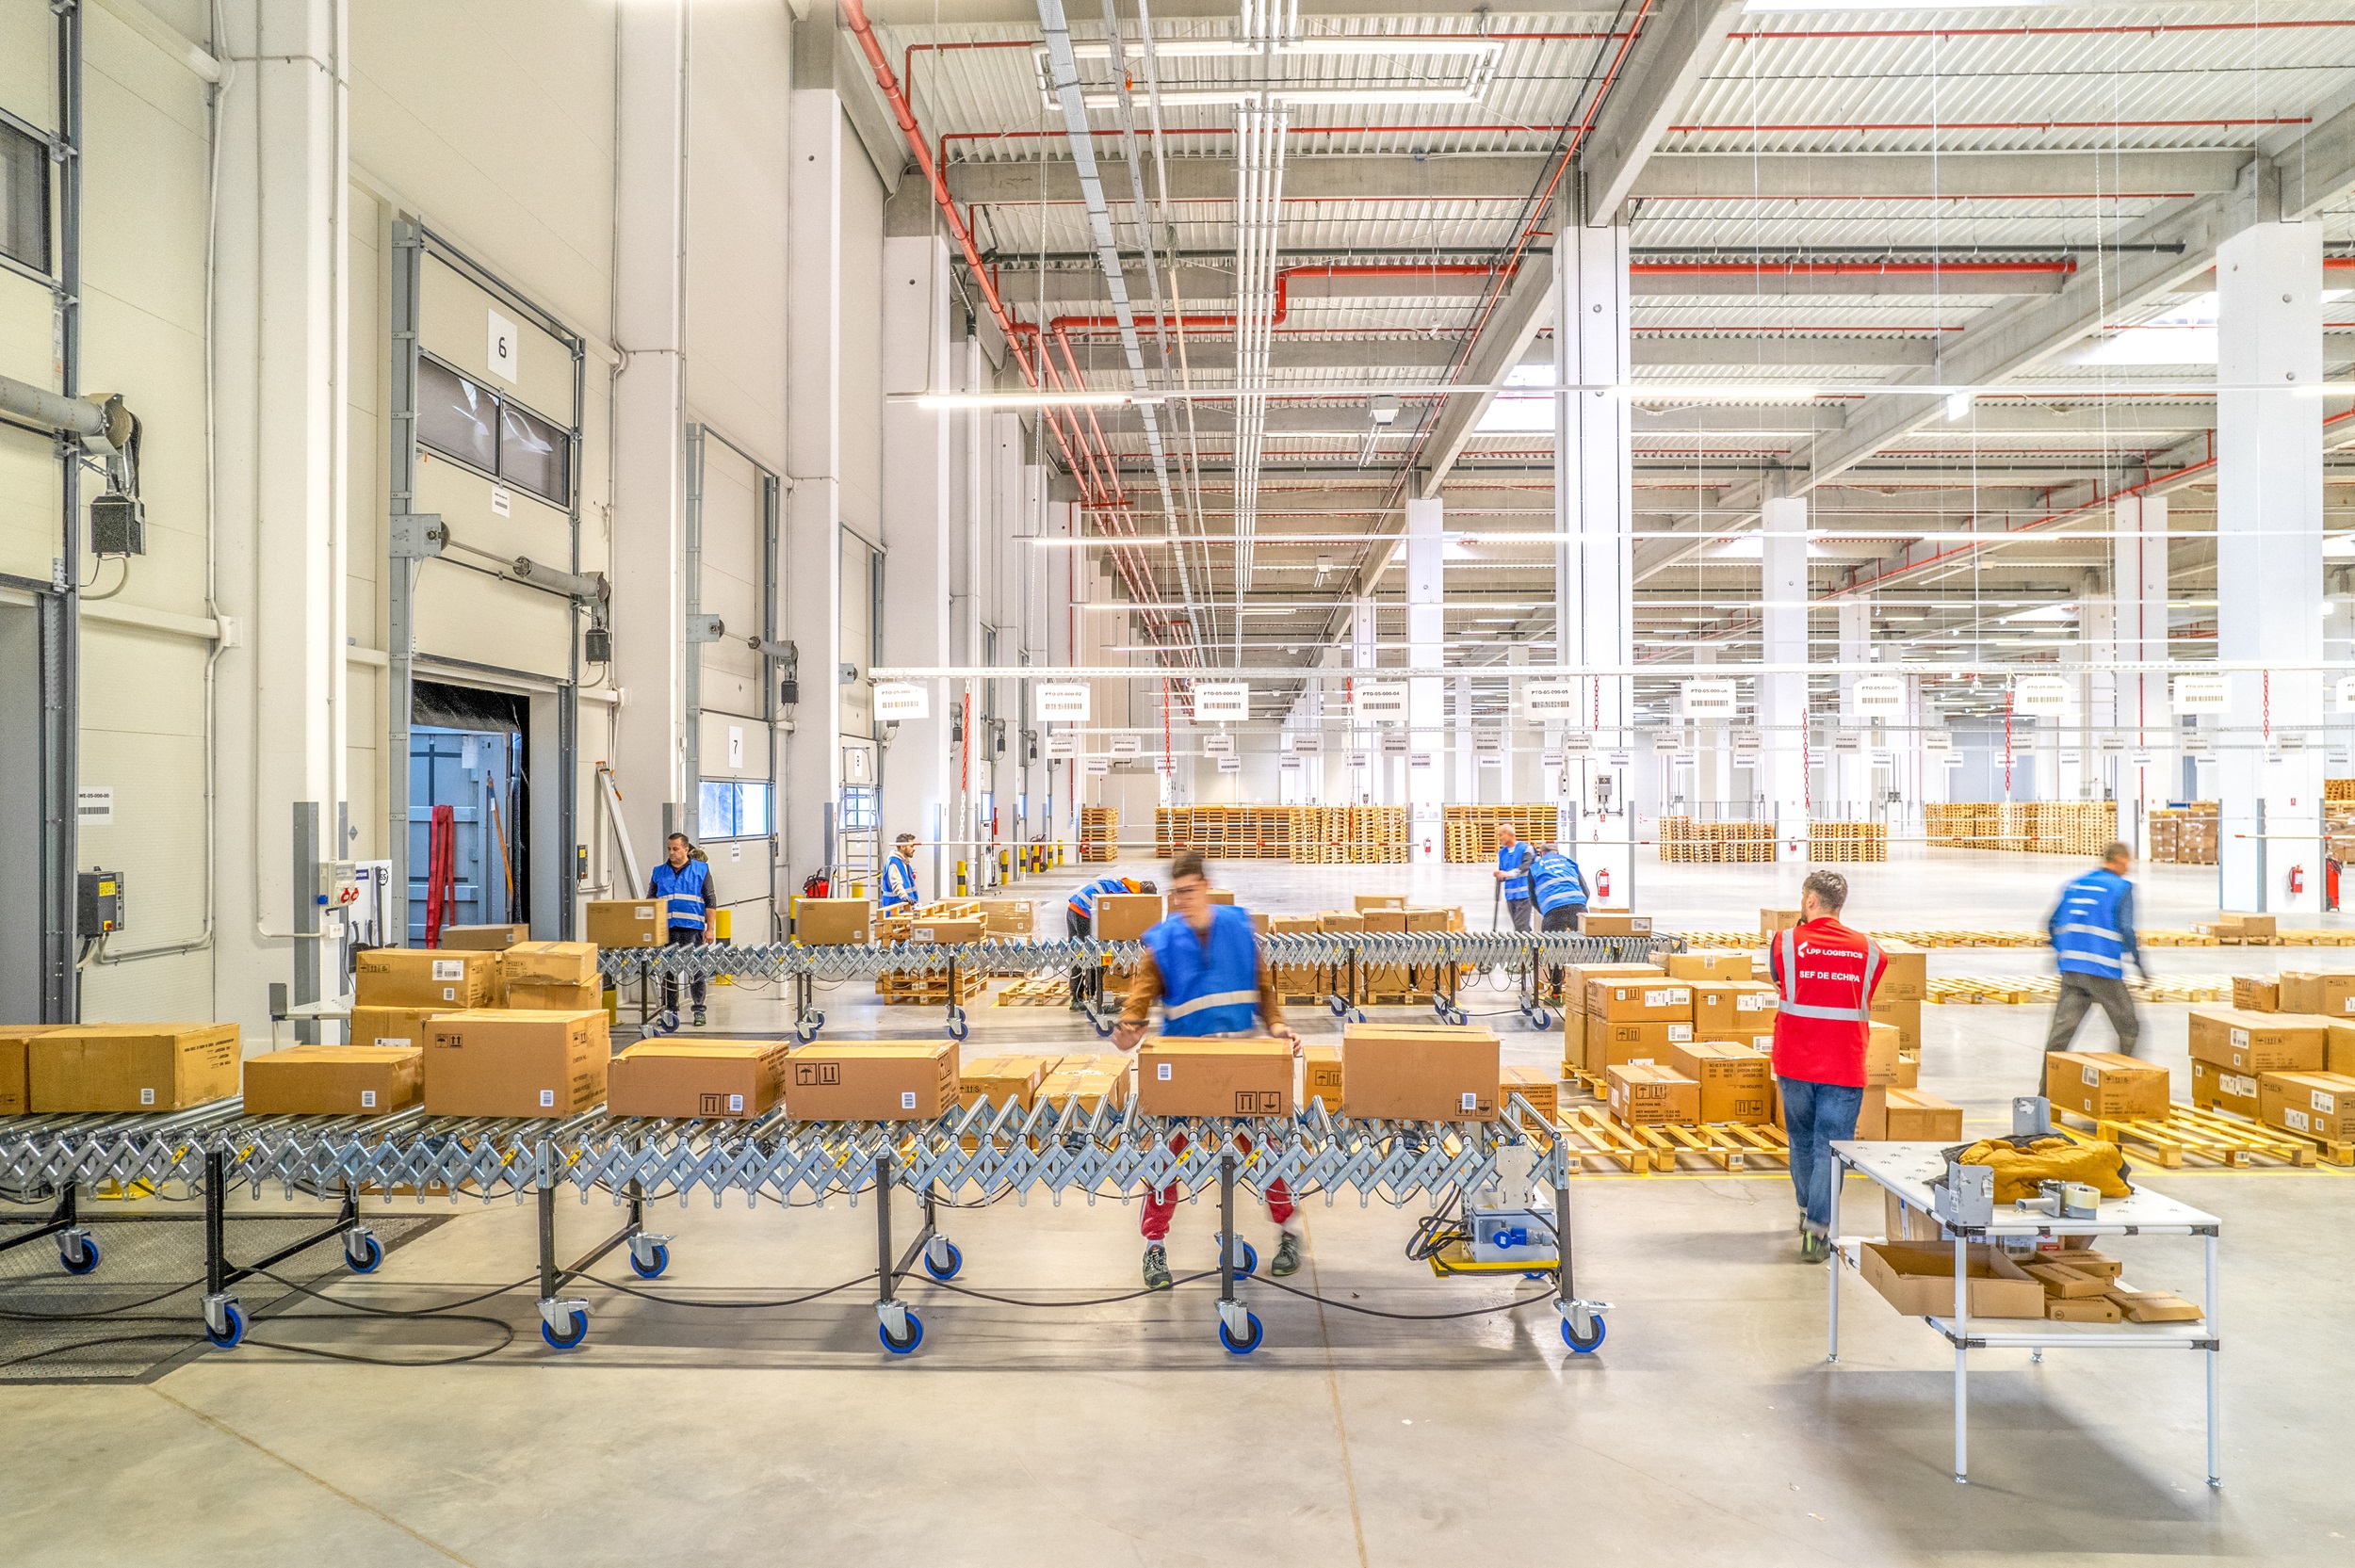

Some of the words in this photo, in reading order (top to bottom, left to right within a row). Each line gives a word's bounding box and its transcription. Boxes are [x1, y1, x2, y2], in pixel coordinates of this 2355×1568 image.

[498, 336, 507, 359] 6
[734, 739, 739, 754] 7
[1822, 949, 1863, 959] LOGISTICS
[1831, 973, 1860, 982] ECHIPA
